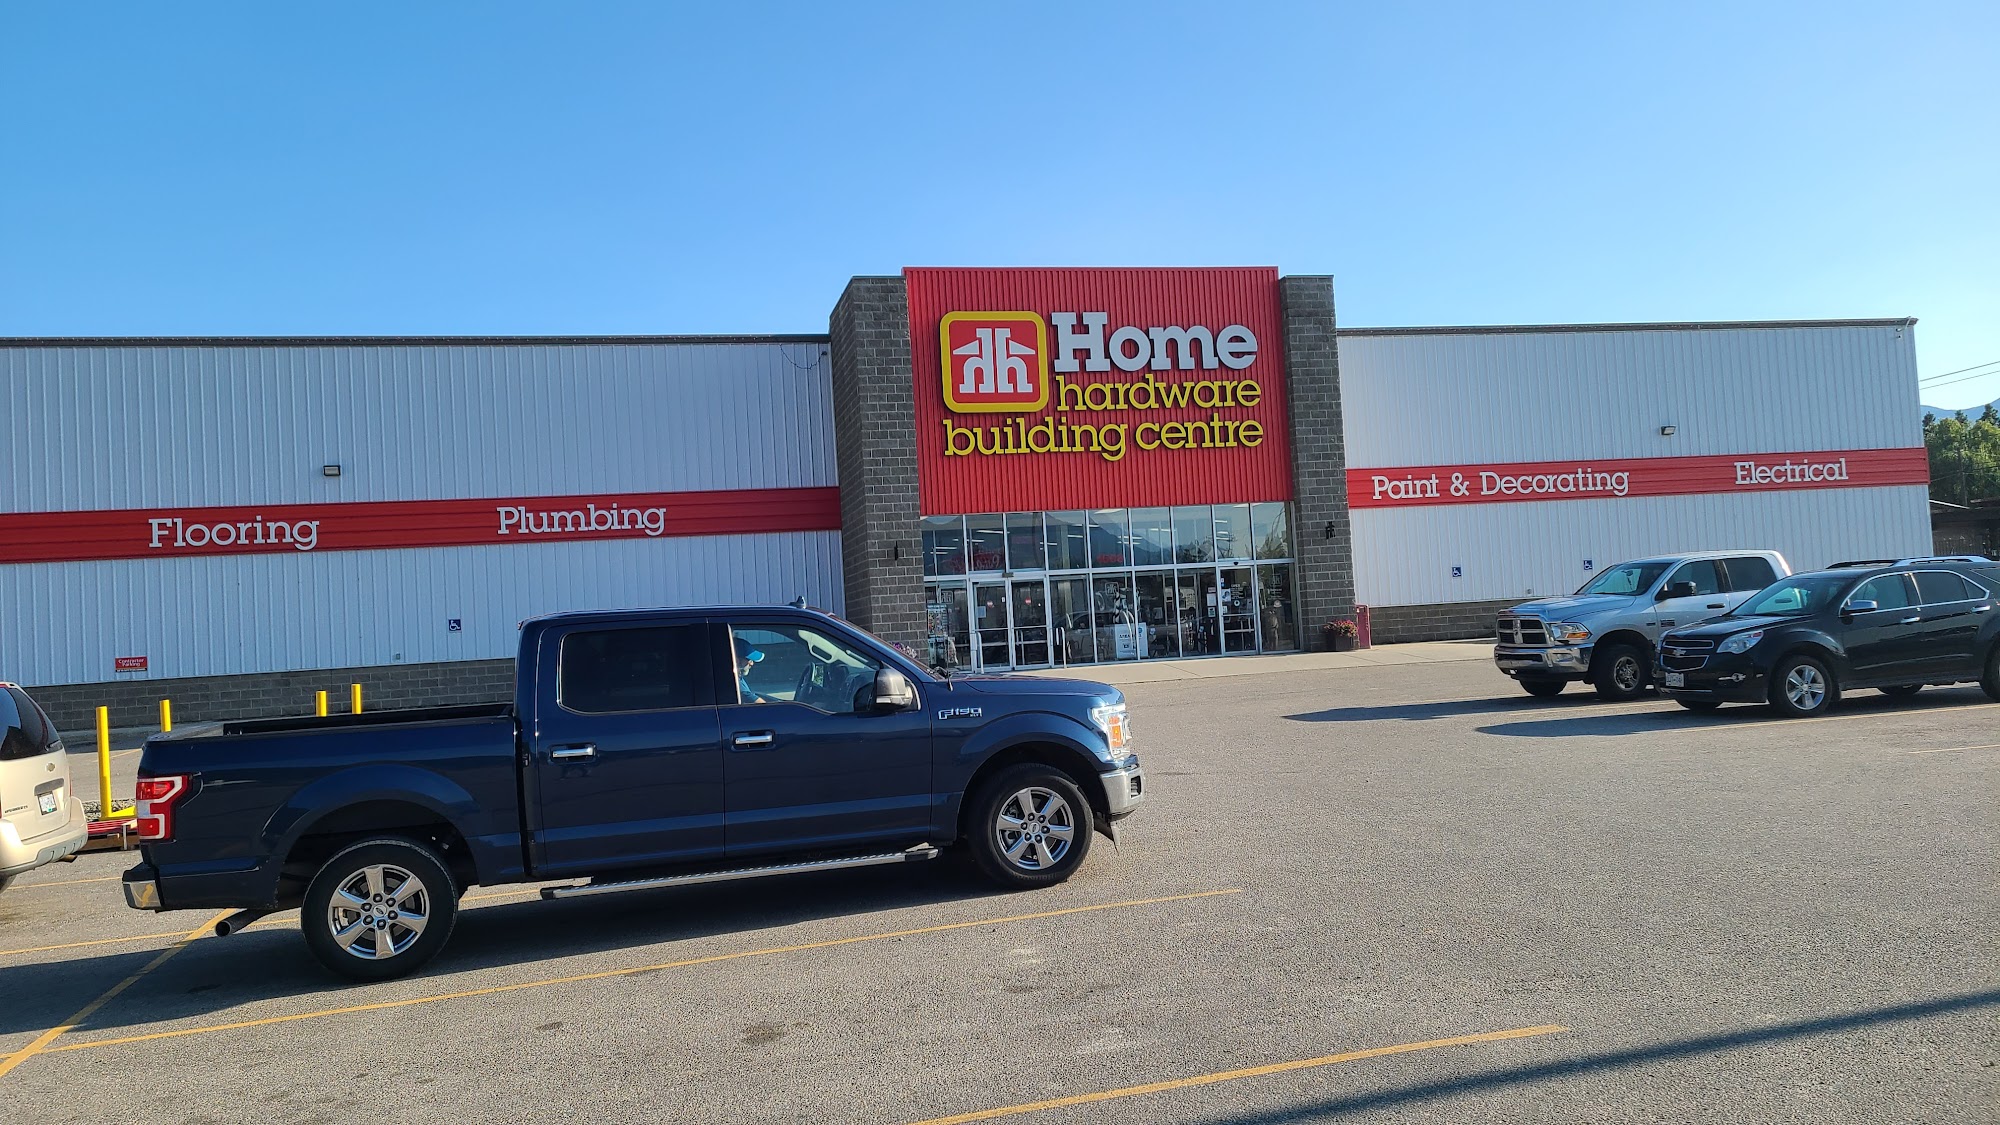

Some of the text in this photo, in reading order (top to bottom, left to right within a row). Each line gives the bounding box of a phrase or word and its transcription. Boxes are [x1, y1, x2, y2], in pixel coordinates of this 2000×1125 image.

[1051, 311, 1258, 372] Home
[1055, 373, 1262, 411] hardware
[942, 412, 1264, 462] building centre
[1371, 467, 1630, 500] Paint & Decorating
[1733, 457, 1849, 485] Electrical
[148, 515, 320, 551] Flooring
[496, 502, 667, 536] Plumbing
